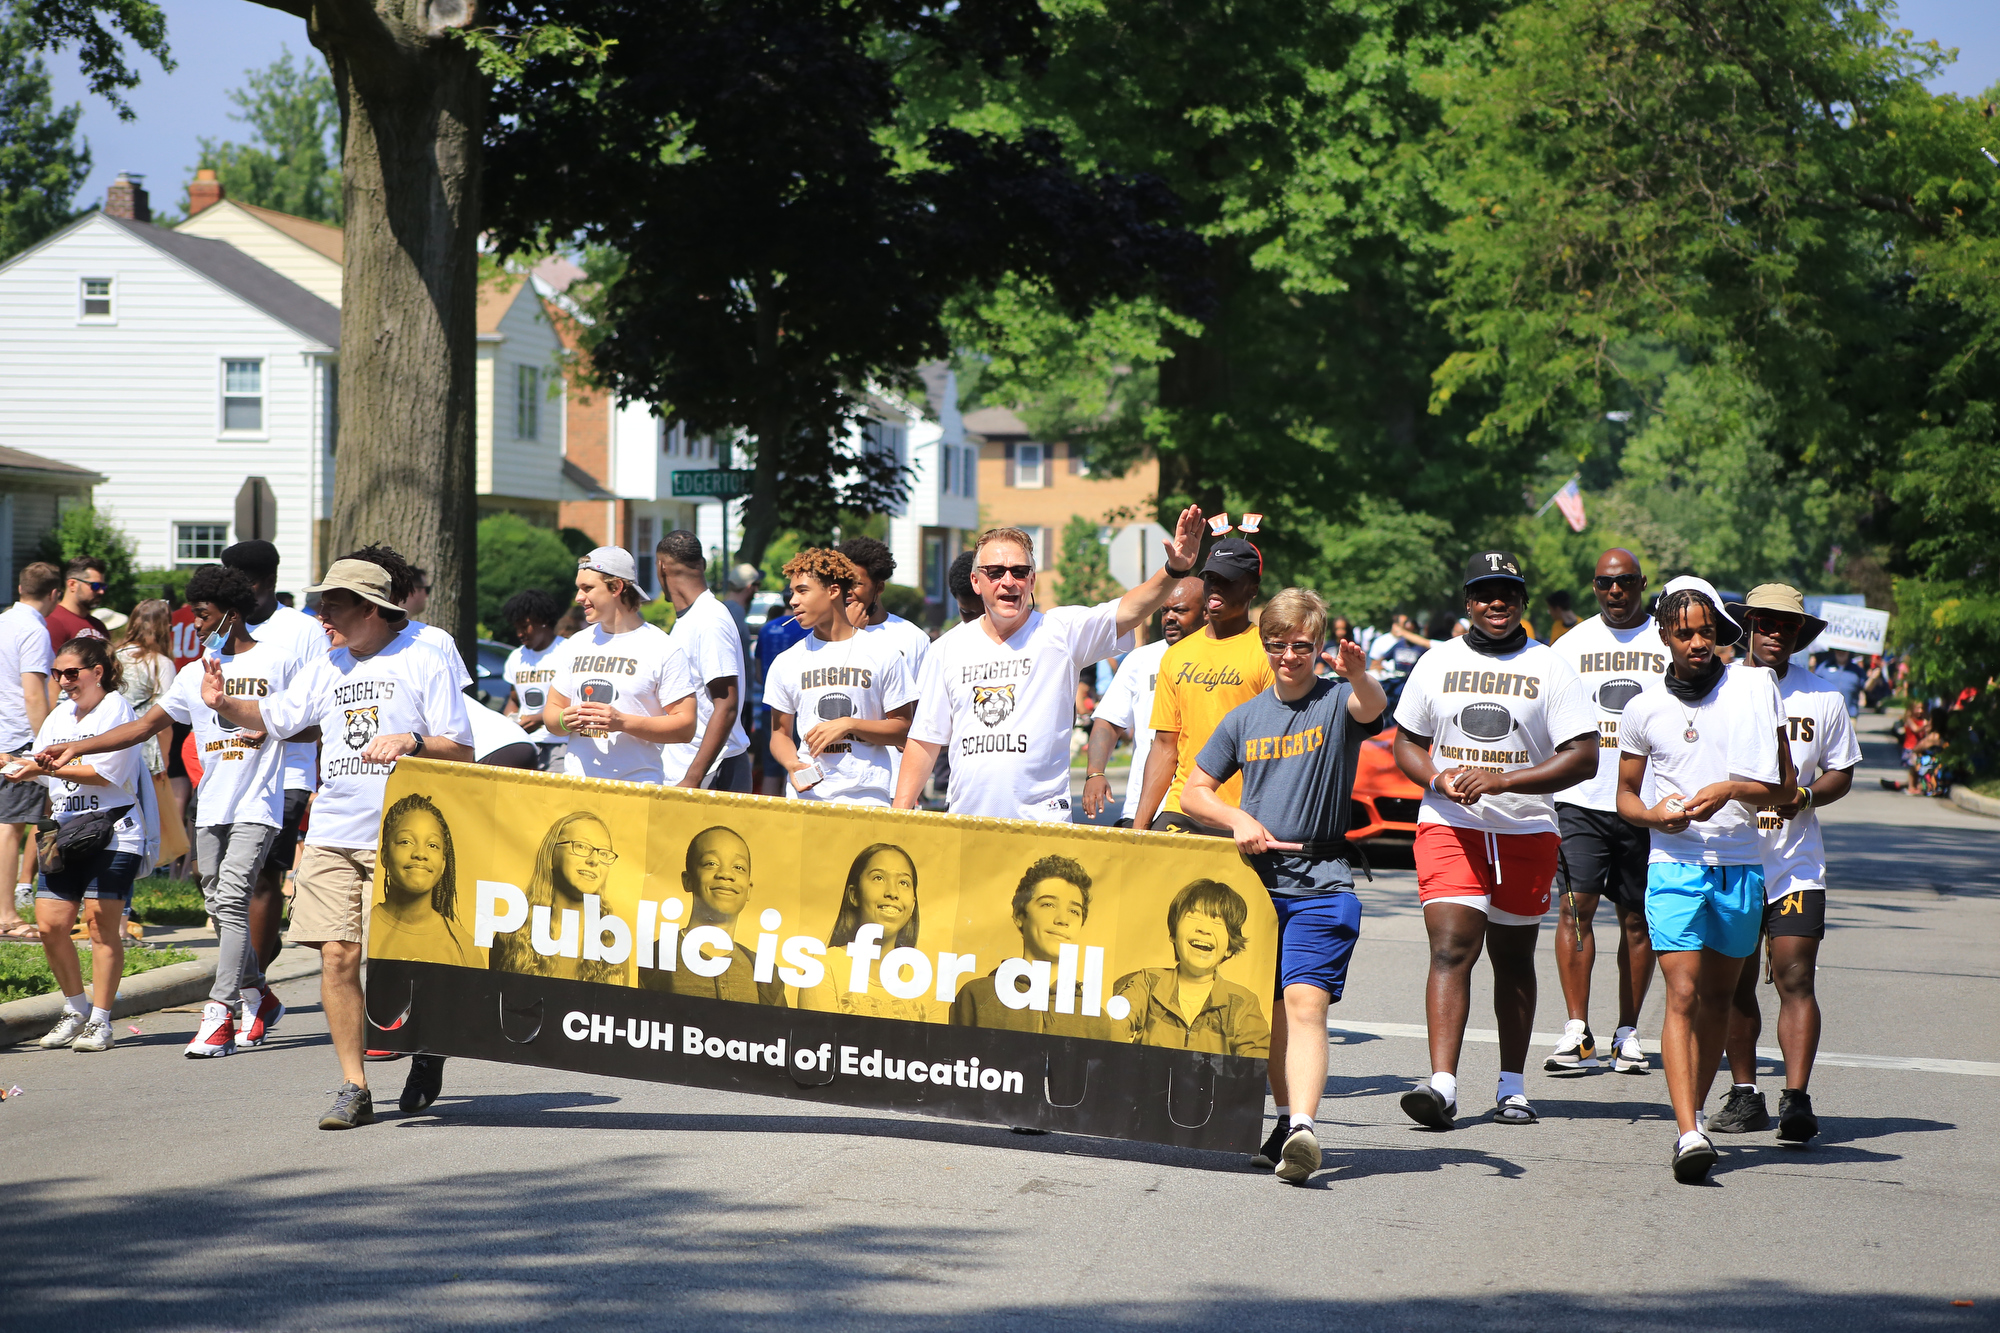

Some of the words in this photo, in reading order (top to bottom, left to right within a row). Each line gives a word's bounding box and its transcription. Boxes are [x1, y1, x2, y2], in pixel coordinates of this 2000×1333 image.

[1485, 553, 1503, 571] T
[172, 622, 199, 658] 10
[1824, 622, 1881, 641] BROWN
[572, 655, 638, 676] HEIGHTS
[962, 658, 1031, 684] HEIGHTS
[1580, 651, 1665, 674] HEIGHTS
[225, 678, 269, 697] GHTS
[516, 669, 556, 685] HEIGHTS
[801, 666, 872, 690] HEIGHTS
[1175, 662, 1244, 692] Heights
[1443, 671, 1540, 700] HEIGHTS
[334, 681, 395, 706] HEIGHTS
[1604, 721, 1617, 733] TO
[823, 743, 852, 754] HAMPS
[962, 734, 1027, 756] SCHOOLS
[1246, 725, 1324, 762] HEIGHTS
[1599, 737, 1619, 748] CHA
[1440, 745, 1464, 760] BACK
[1466, 748, 1480, 762] TO
[1482, 750, 1513, 764] BACK
[474, 880, 734, 977] Public
[753, 908, 826, 988] is
[846, 923, 976, 1003] for
[994, 943, 1131, 1020] all.
[562, 1011, 673, 1052] CH-UH
[682, 1025, 786, 1067] Board
[794, 1043, 832, 1071] of
[840, 1046, 1024, 1094] Education
